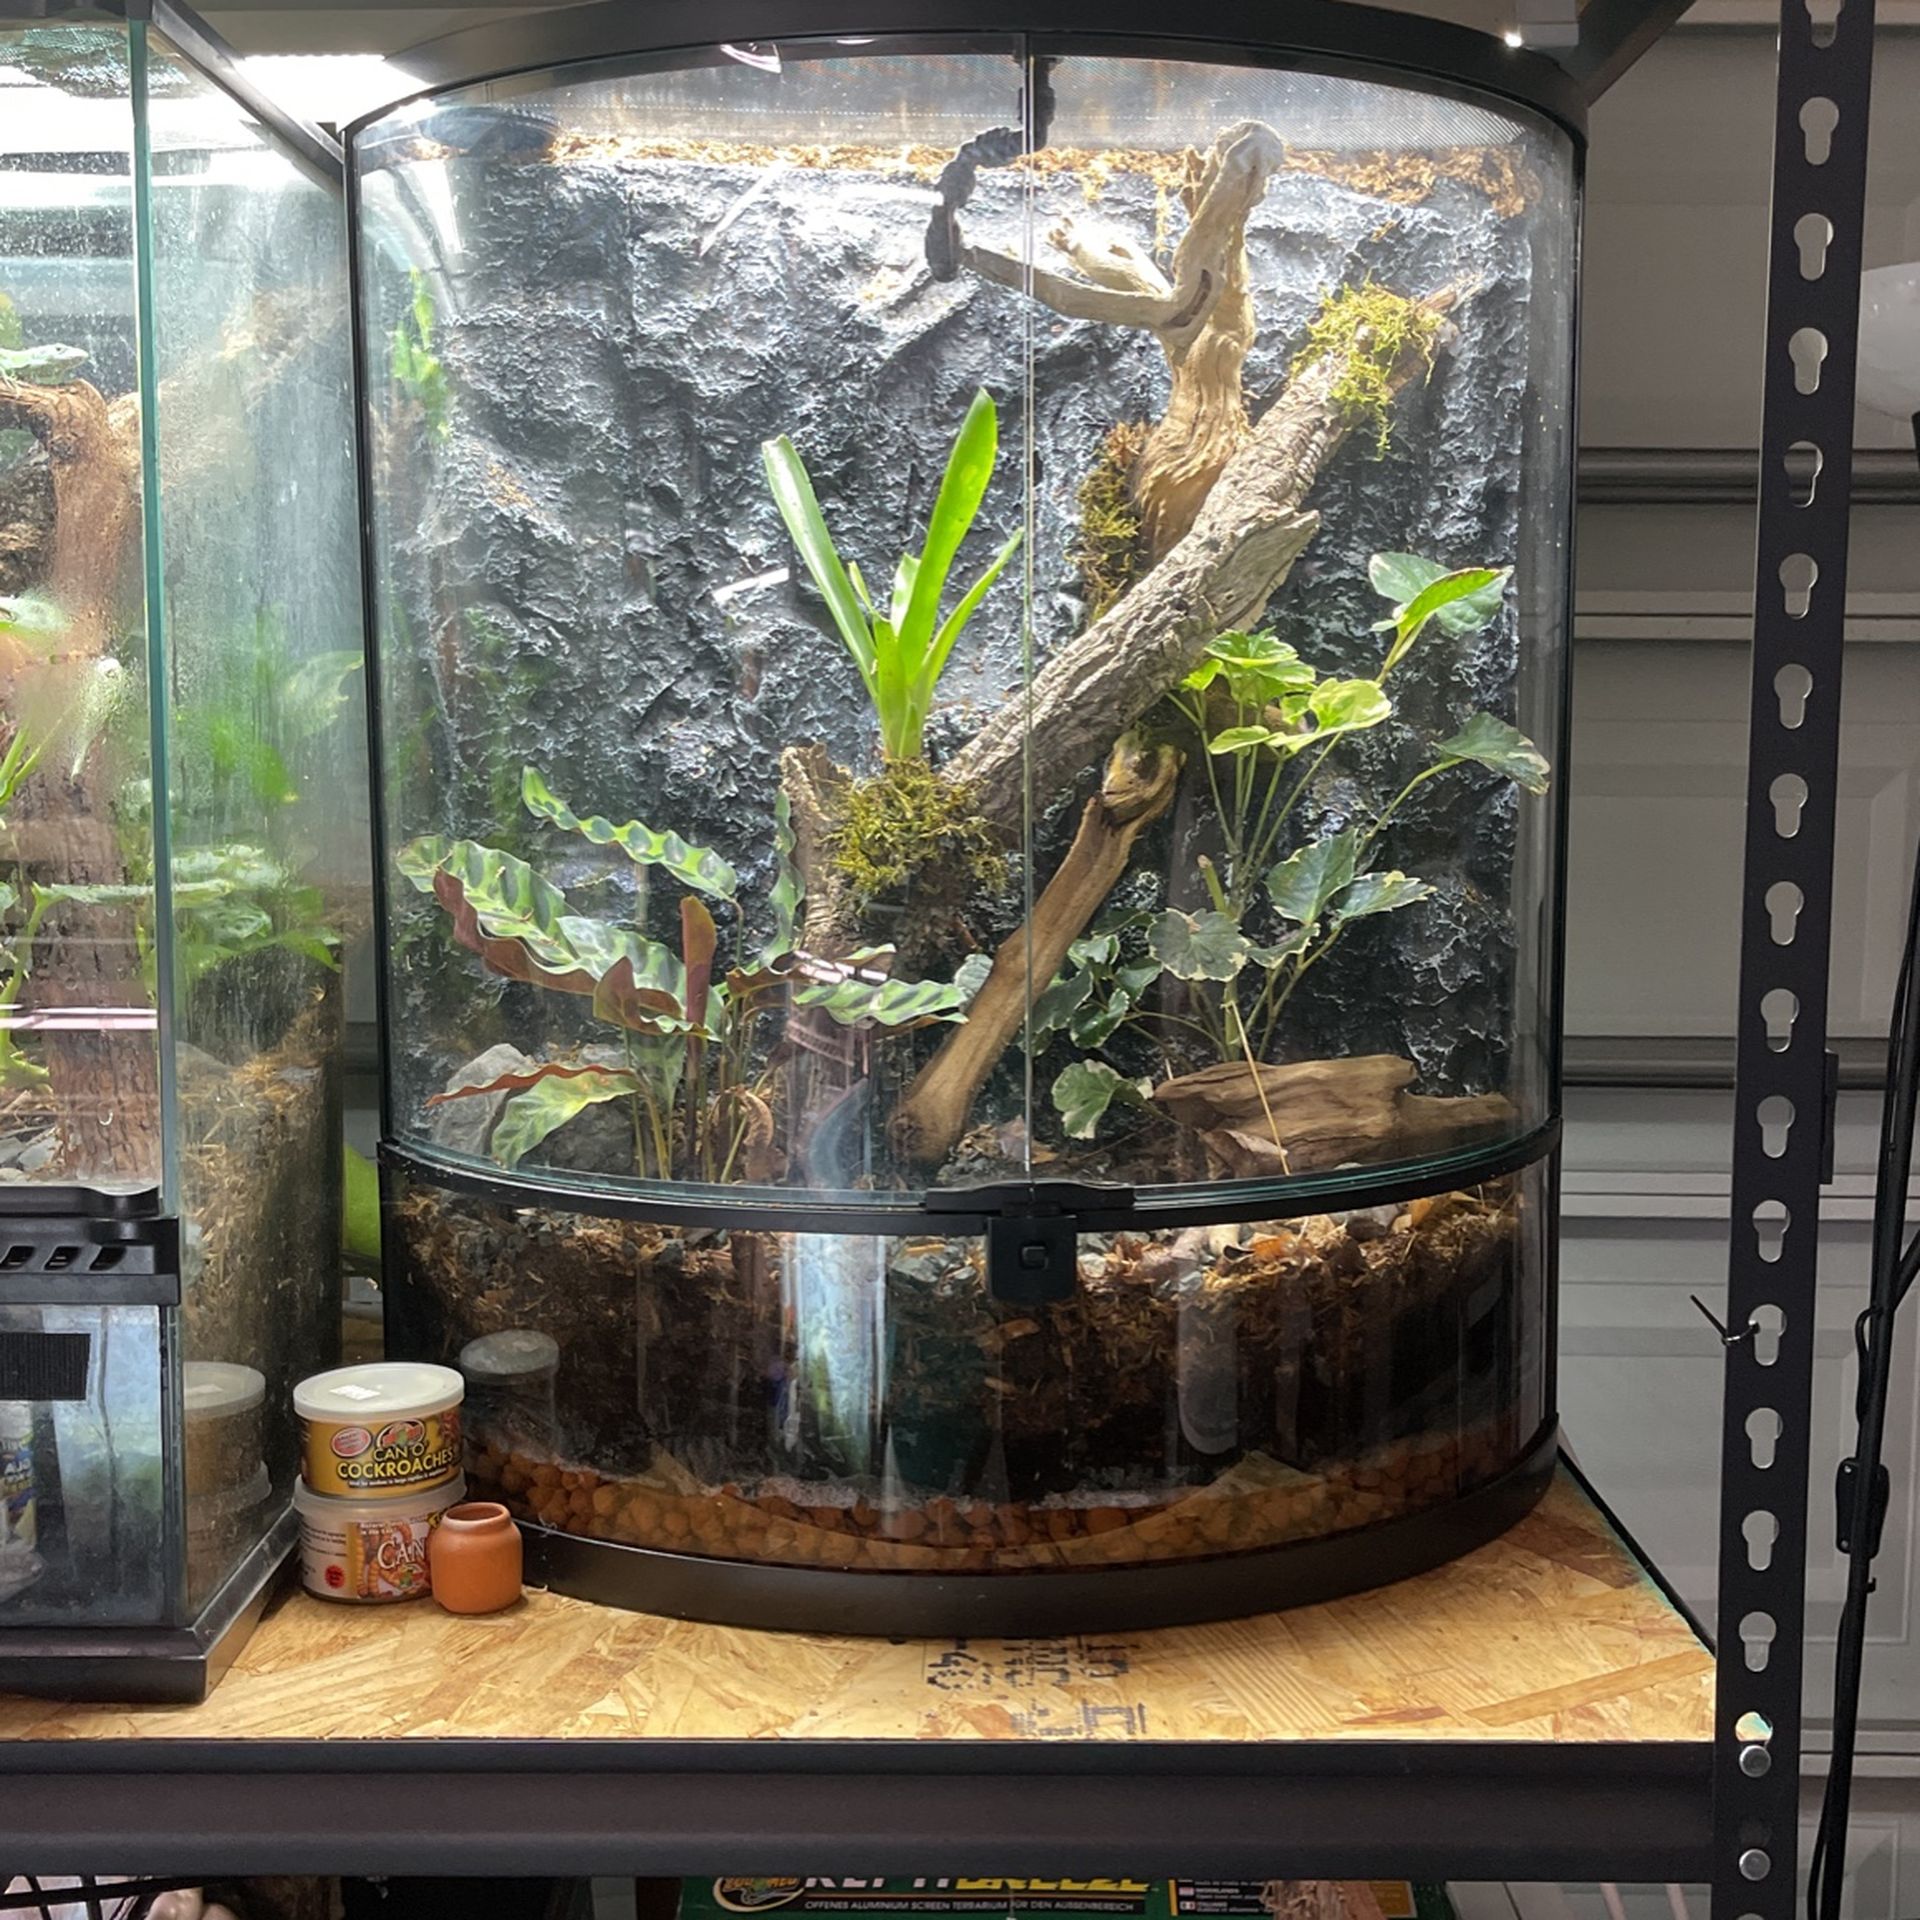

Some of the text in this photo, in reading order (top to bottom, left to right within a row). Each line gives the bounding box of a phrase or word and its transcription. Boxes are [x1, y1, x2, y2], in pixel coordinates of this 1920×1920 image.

[337, 1449, 454, 1479] COCKROACHES
[374, 1445, 408, 1462] CAN
[377, 1537, 426, 1569] CAN
[911, 1901, 951, 1910] SCREEN
